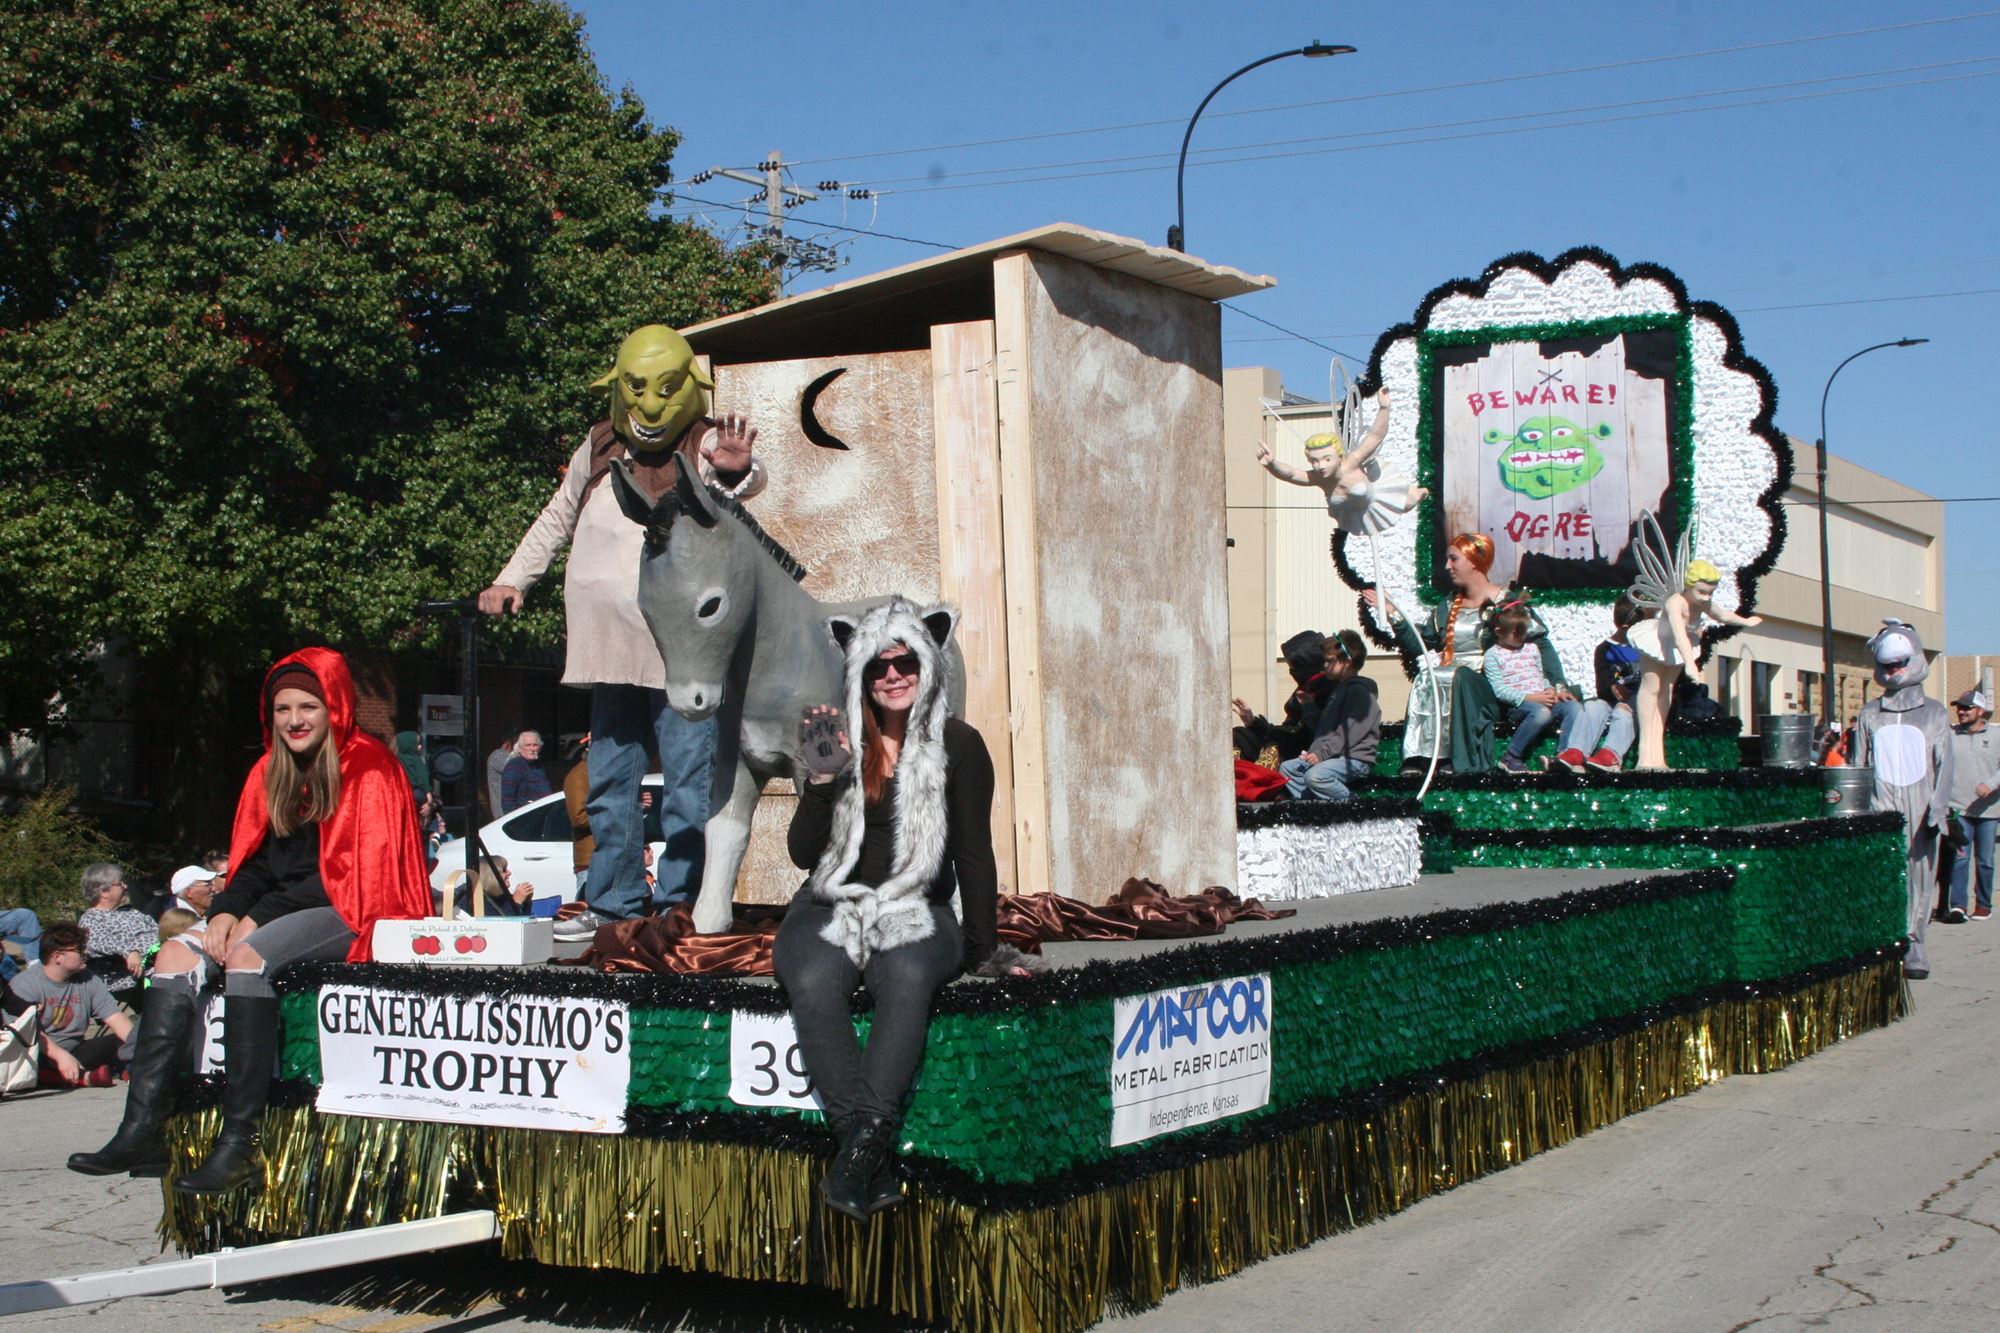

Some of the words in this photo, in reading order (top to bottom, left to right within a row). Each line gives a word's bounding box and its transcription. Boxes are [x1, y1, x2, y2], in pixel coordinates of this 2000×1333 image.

[1467, 384, 1616, 416] BEWARE!
[1506, 511, 1592, 543] OGRE
[409, 925, 427, 933] Fresh
[460, 925, 488, 933] Delicious
[320, 992, 624, 1054] GENERALISSIMO'S
[1116, 977, 1268, 1060] MATCOR
[374, 1046, 568, 1099] TROPHY
[750, 1040, 816, 1099] 39
[1114, 1065, 1168, 1092] METAL
[1174, 1041, 1268, 1079] FABRICATION
[1150, 1103, 1210, 1129] Independence,
[1212, 1094, 1240, 1112] Kansas
